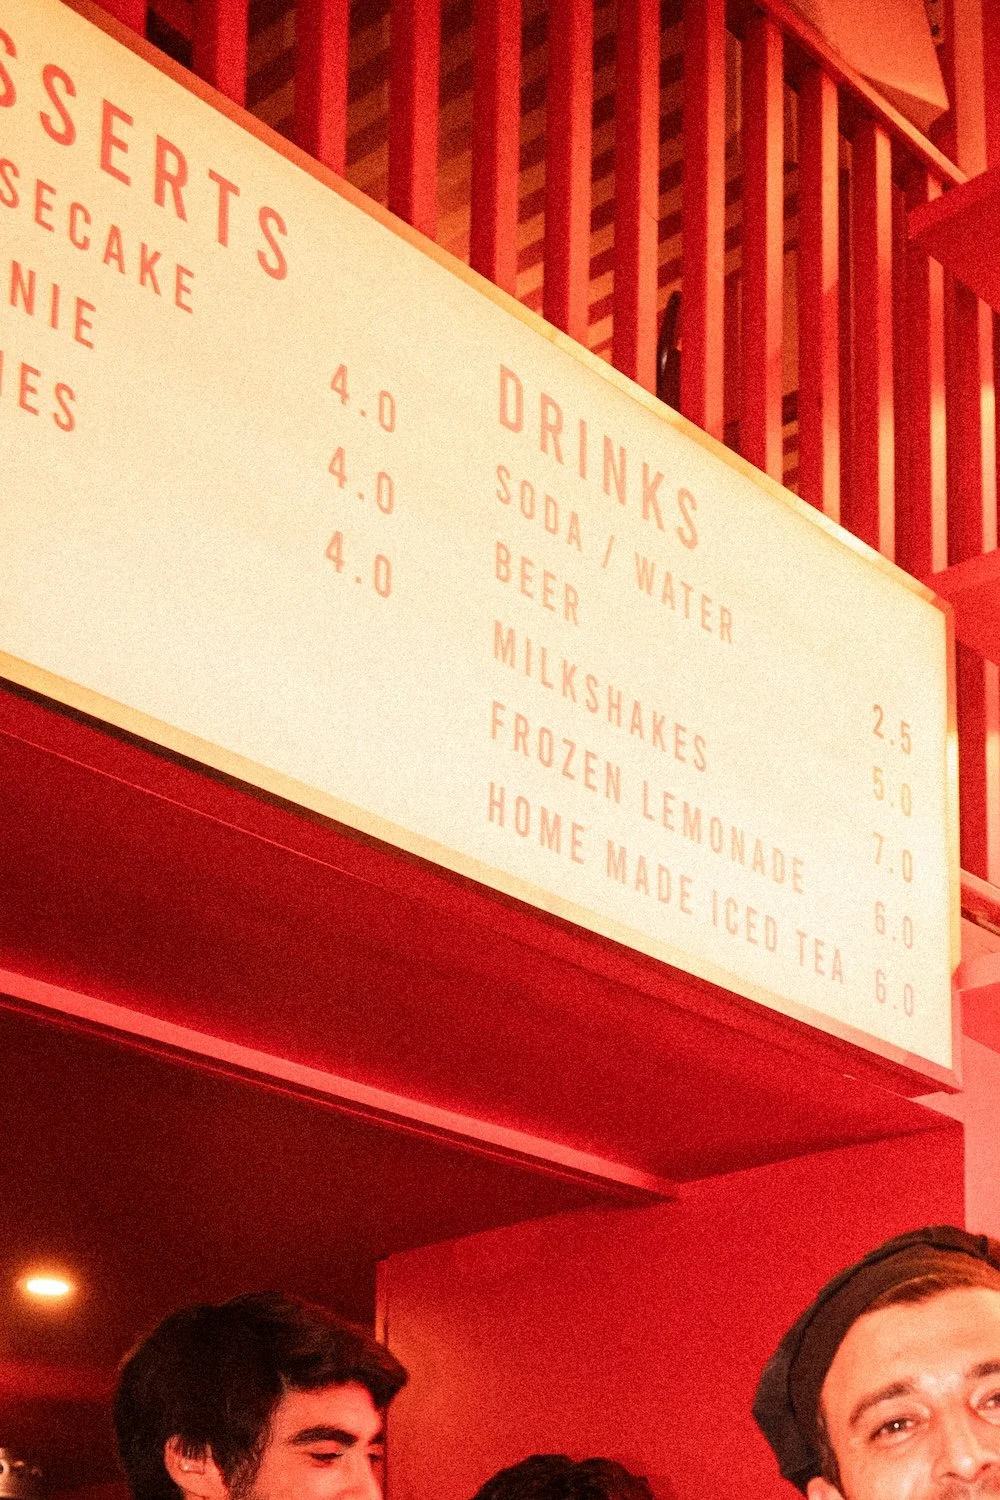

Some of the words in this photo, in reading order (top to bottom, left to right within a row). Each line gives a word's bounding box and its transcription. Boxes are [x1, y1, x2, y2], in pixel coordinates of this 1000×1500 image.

[9, 260, 97, 350] NIE
[330, 363, 396, 433] 4.0
[327, 446, 394, 515] 4.0
[499, 363, 700, 550] DRINKS
[325, 529, 392, 598] 4.0
[495, 540, 581, 626] BEER
[496, 464, 583, 554] SODA
[635, 551, 734, 646] WATER
[492, 619, 708, 773] MILKSHAKES
[872, 703, 913, 756] 2.5
[491, 700, 622, 804] FROZEN
[642, 780, 805, 895] LEMONADE
[872, 765, 913, 817] 5.0
[488, 781, 585, 866] HOME
[606, 838, 694, 916] MADE
[711, 888, 778, 954] ICED
[796, 929, 845, 985] TEA
[872, 831, 914, 884] 7.0
[874, 900, 914, 950] 6.0
[874, 968, 915, 1018] 6.0
